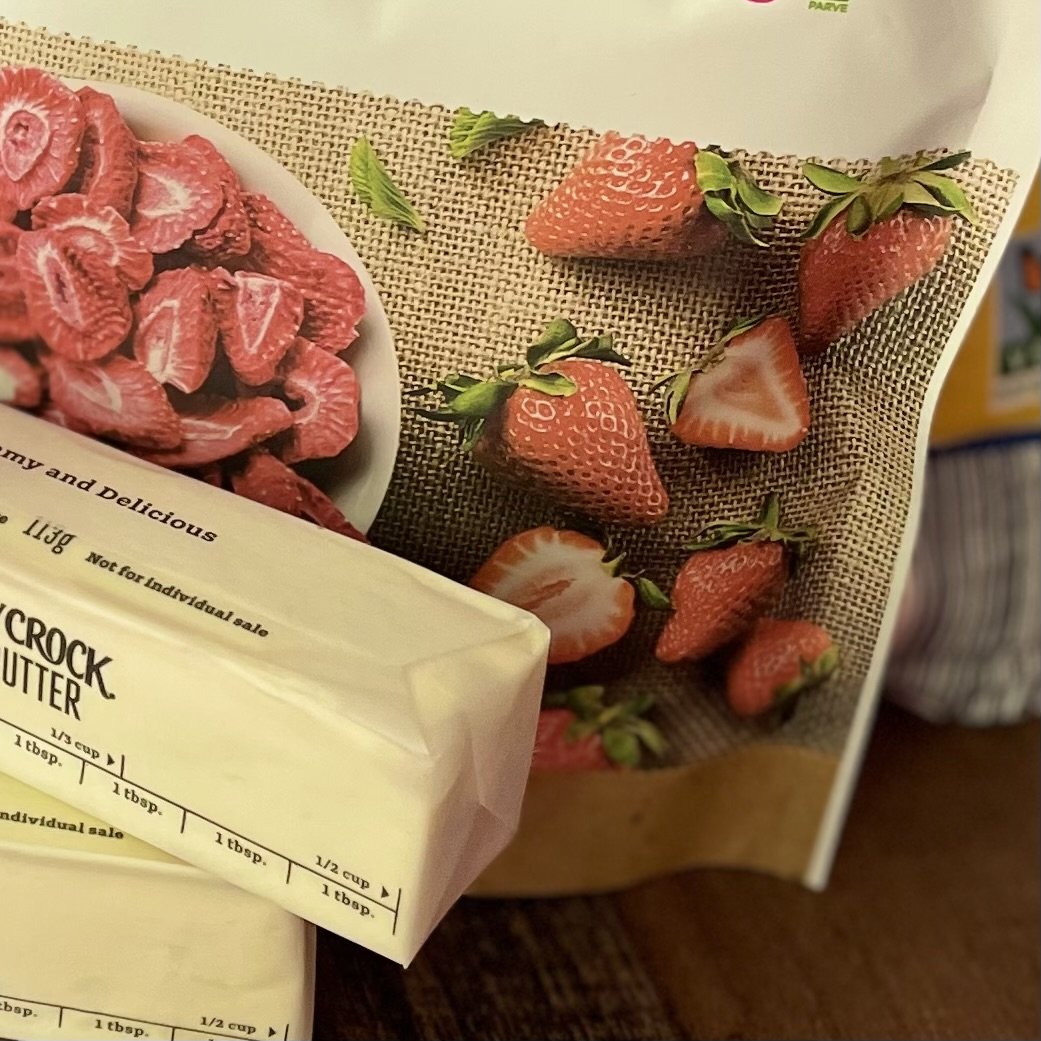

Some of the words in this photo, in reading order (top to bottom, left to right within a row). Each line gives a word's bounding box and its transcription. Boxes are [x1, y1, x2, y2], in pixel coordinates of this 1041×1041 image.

[808, 1, 848, 13] PARVE
[45, 467, 97, 492] and
[96, 484, 219, 544] Delicious
[22, 518, 76, 554] 113g
[85, 550, 115, 570] Not
[117, 560, 144, 587] for
[144, 570, 232, 622] individual
[229, 610, 269, 638] sale
[14, 734, 23, 748] 1
[26, 737, 63, 767] tbsp.
[49, 727, 72, 746] 1/3
[73, 741, 101, 761] cup
[112, 782, 121, 796] 1
[124, 785, 163, 817] tbsp.
[85, 821, 125, 840] sale
[215, 832, 224, 846] 1
[227, 834, 268, 867] tbsp.
[315, 855, 340, 875] 1/2
[342, 868, 371, 890] cup
[321, 883, 331, 897] 1
[334, 886, 376, 919] tbsp.
[95, 1019, 103, 1029] 1
[109, 1021, 149, 1037] tbsp.
[200, 1017, 224, 1028] 1/2
[228, 1022, 256, 1034] cup
